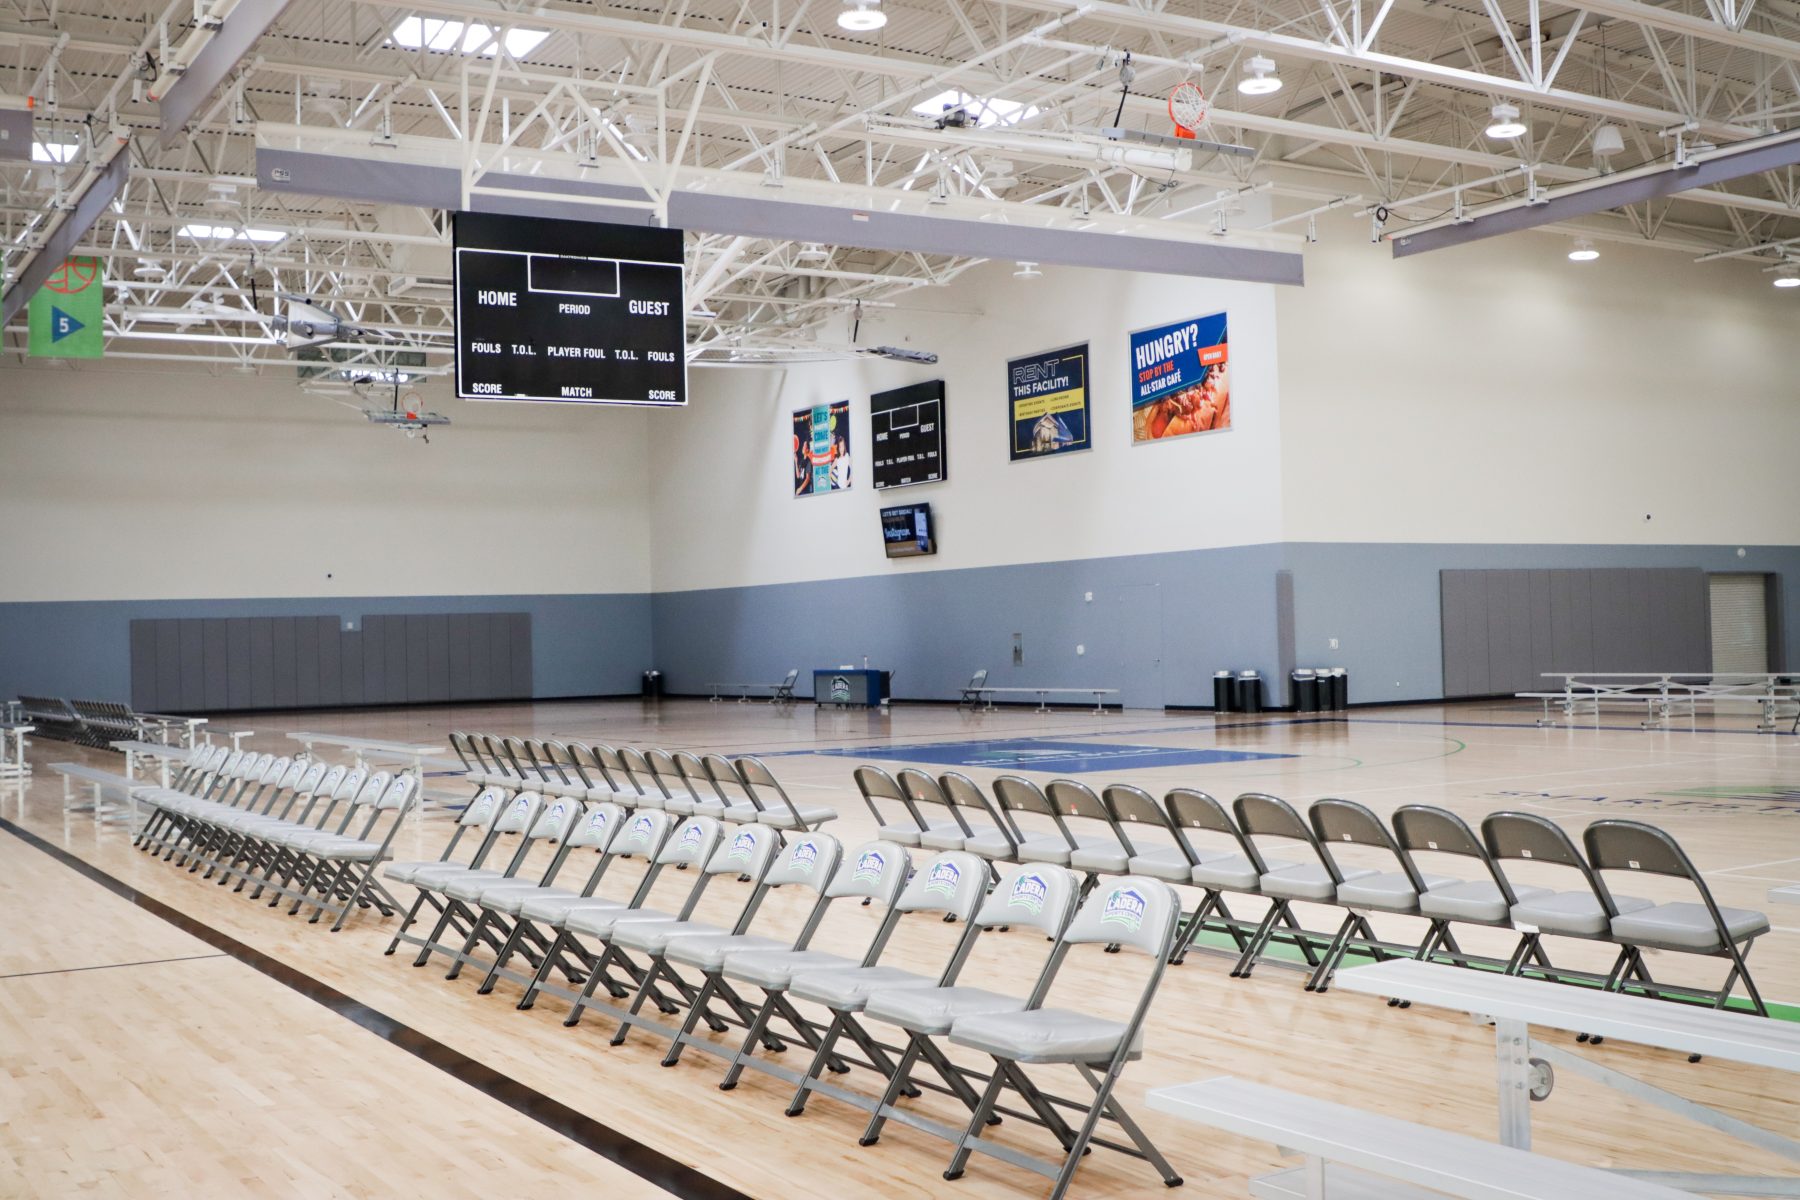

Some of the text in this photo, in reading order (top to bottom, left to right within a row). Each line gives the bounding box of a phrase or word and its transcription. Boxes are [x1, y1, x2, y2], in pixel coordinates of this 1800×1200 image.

[478, 290, 517, 307] HOME
[559, 304, 590, 315] PERIOD
[629, 300, 669, 316] GUEST
[60, 318, 69, 332] 5
[472, 343, 501, 354] FOULS
[512, 344, 536, 356] T.O.L.
[547, 347, 606, 359] PLAYER FOUL
[1136, 324, 1198, 370] HUNGRY?
[615, 350, 638, 360] T.O.L.
[648, 352, 675, 362] FOULS
[1013, 359, 1059, 384] RENT
[1139, 360, 1174, 382] STOP BY THE
[472, 383, 502, 393] SCORE
[1014, 376, 1069, 397] THIS FACILITY!
[1140, 368, 1182, 396] ALL-STAR CAFÉ
[561, 387, 592, 397] MATCH
[649, 390, 675, 400] SCORE
[814, 412, 828, 425] LET'S
[920, 423, 934, 433] GUEST
[930, 869, 958, 886] LADERA
[1014, 882, 1044, 899] LADERA
[1107, 896, 1142, 916] LADERA
